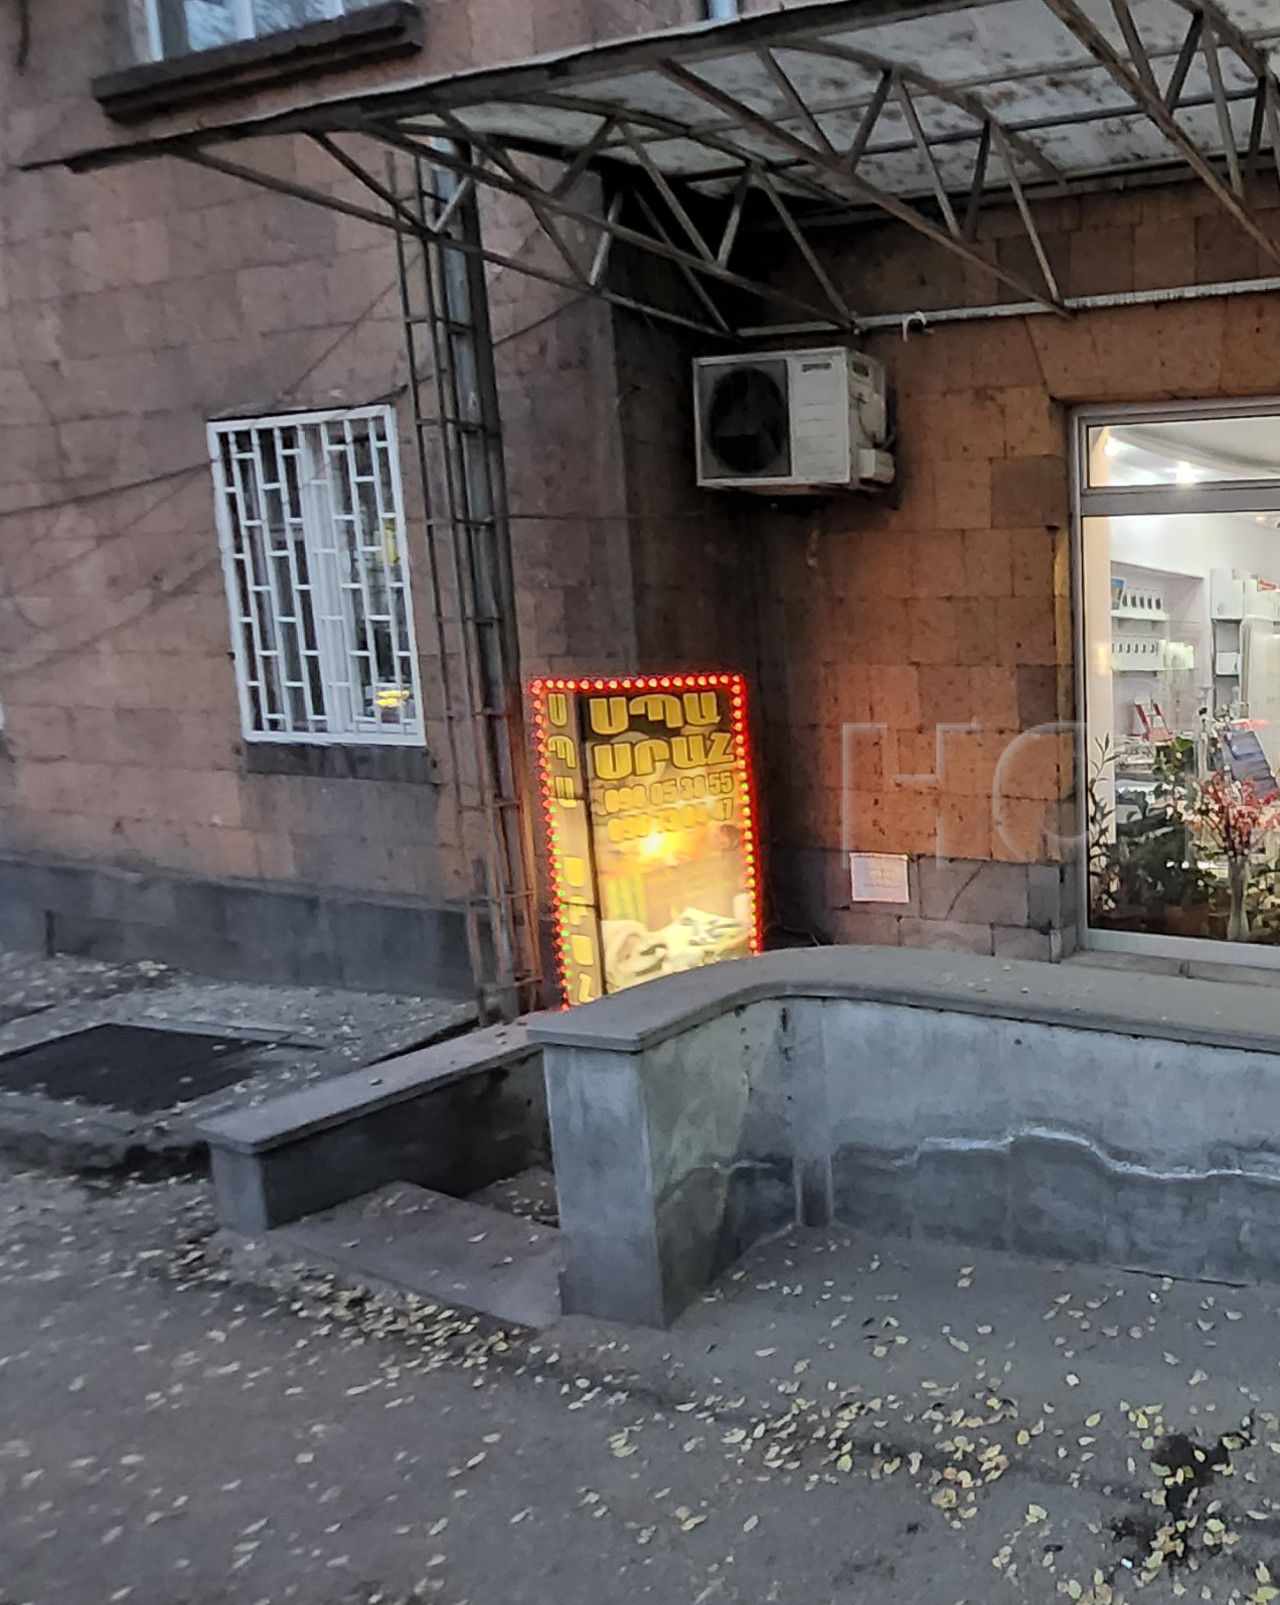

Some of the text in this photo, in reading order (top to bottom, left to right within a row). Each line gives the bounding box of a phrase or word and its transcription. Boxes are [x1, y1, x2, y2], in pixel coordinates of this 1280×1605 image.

[588, 691, 722, 736] ՍՊԱ
[594, 733, 736, 780] ՍՐԱՀ
[709, 771, 735, 795] 55
